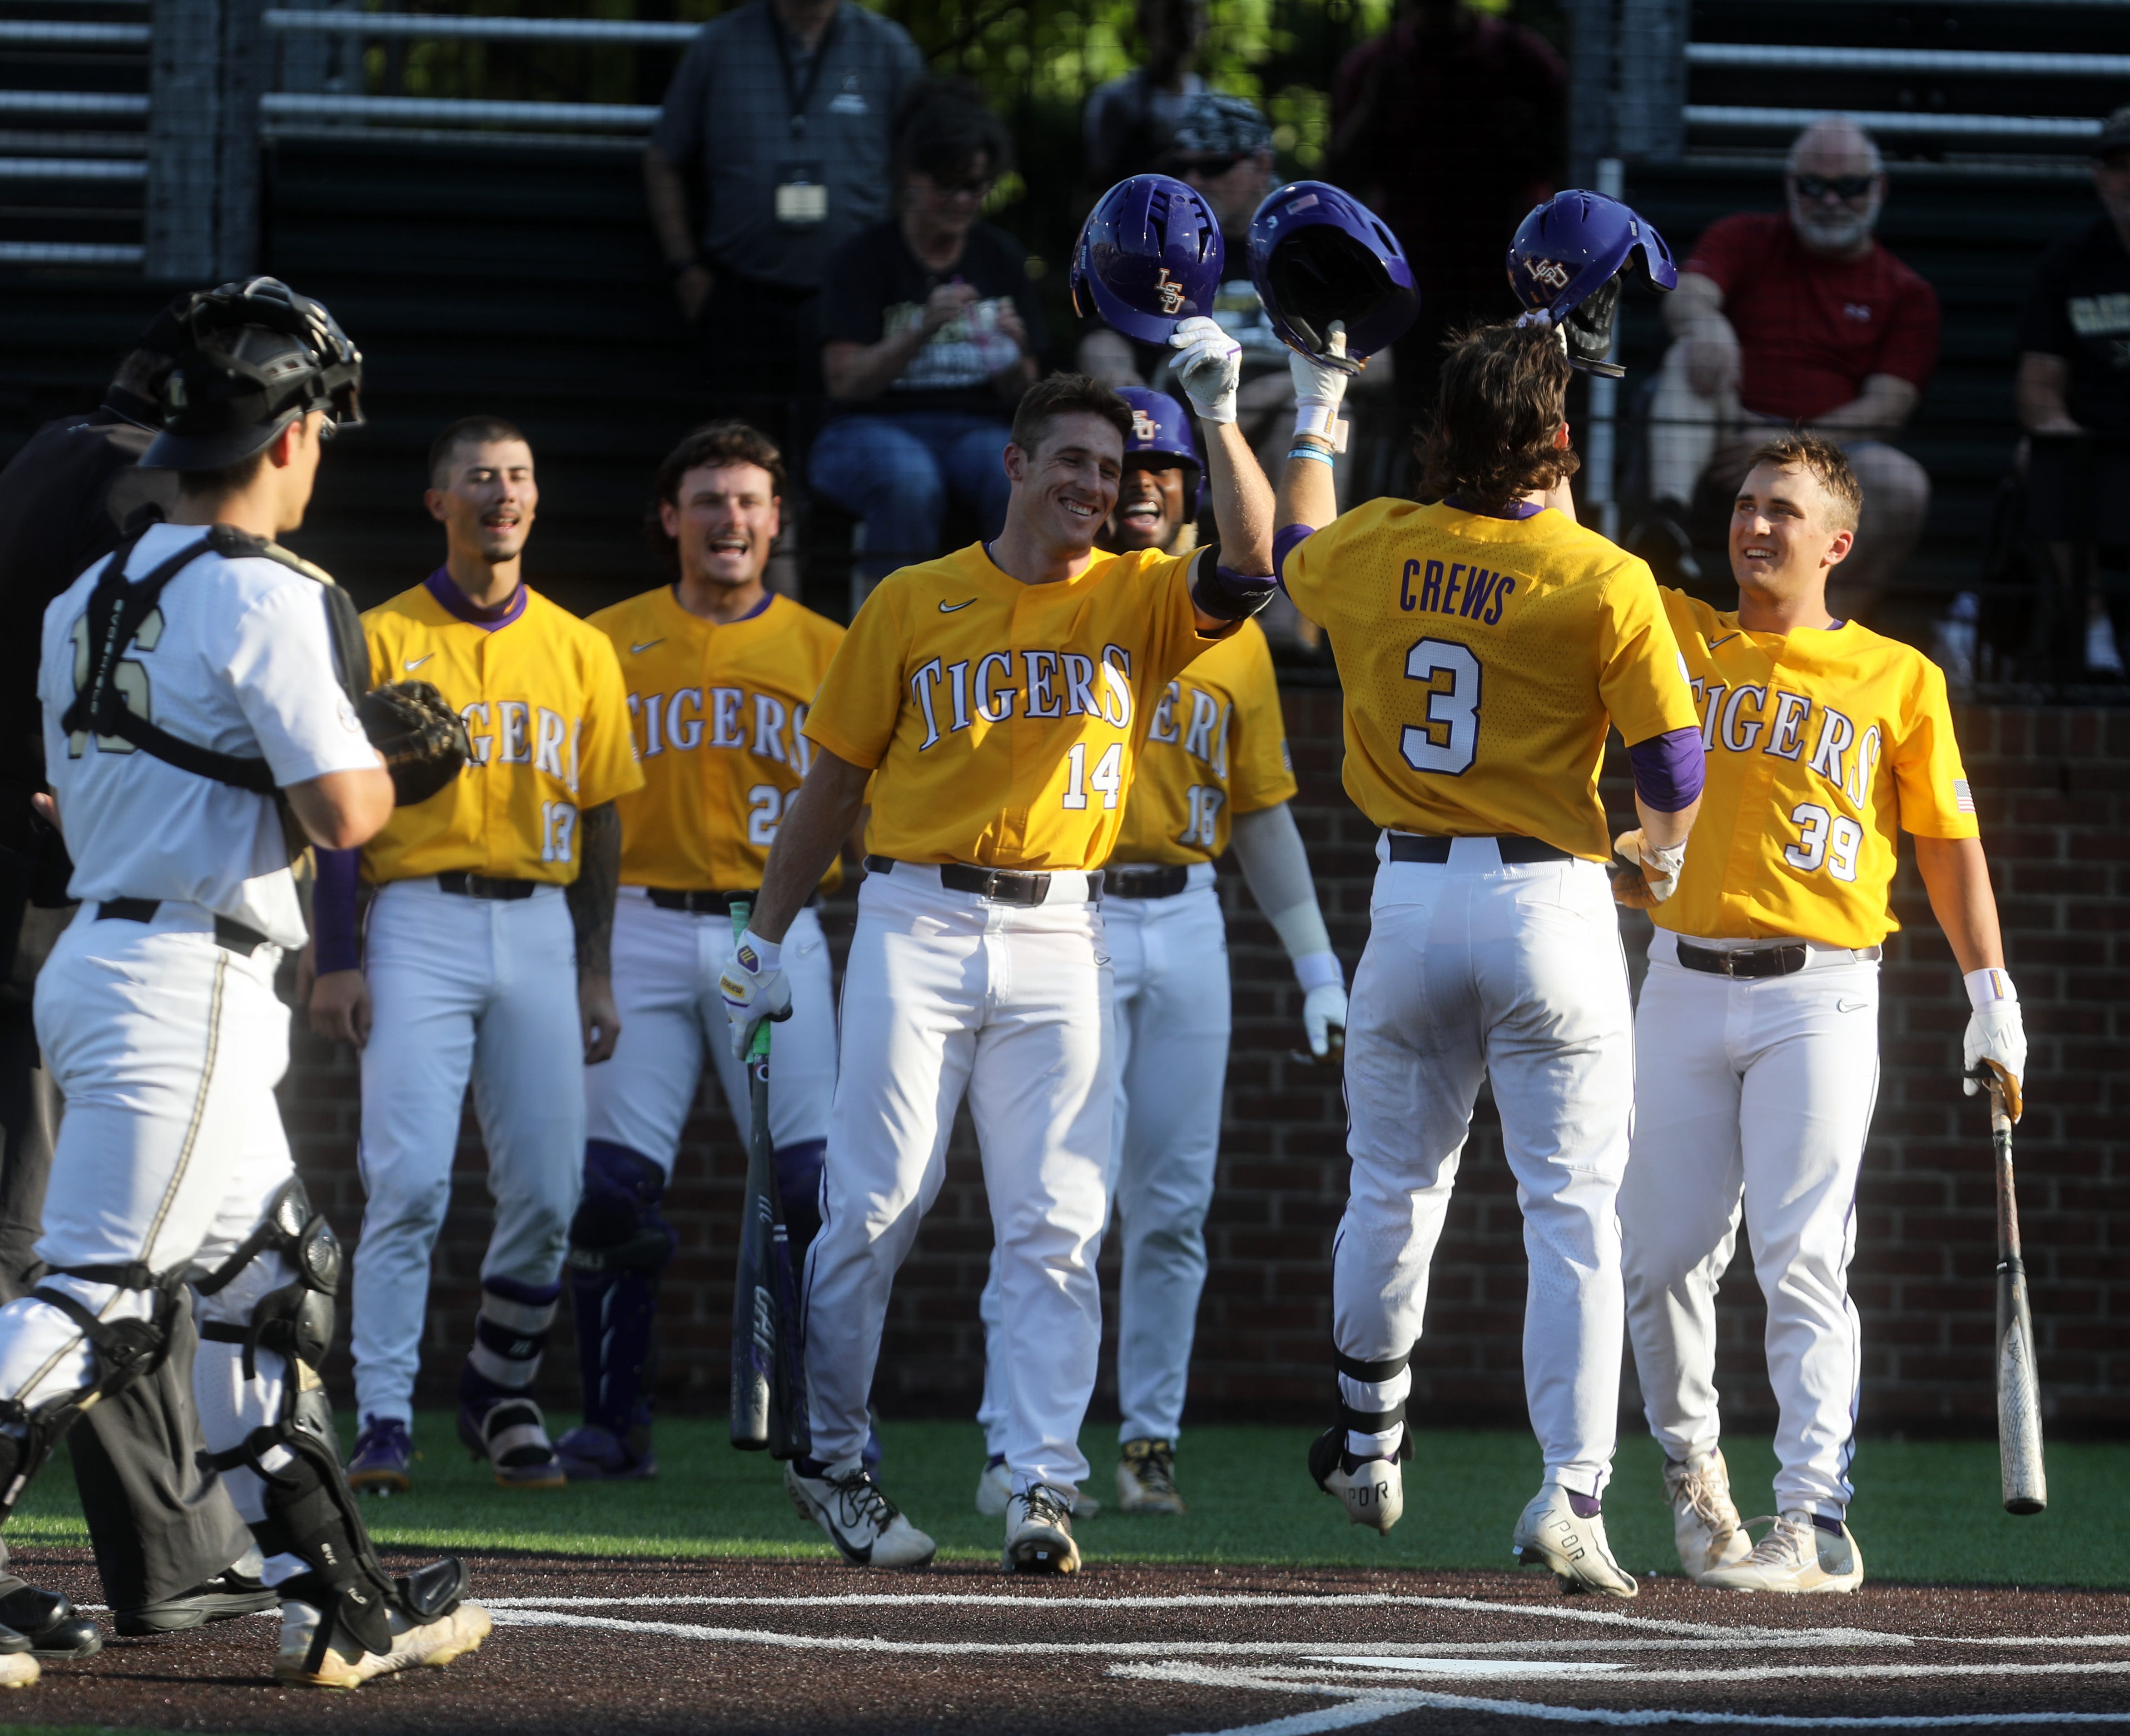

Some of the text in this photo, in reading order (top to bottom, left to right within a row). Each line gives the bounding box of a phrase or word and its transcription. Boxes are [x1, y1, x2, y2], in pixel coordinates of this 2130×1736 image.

[1154, 268, 1185, 314] LSU
[1523, 258, 1569, 289] LSU
[1132, 410, 1156, 440] SU
[1400, 559, 1516, 626] CREWS
[911, 643, 1132, 752] TIGERS
[1399, 636, 1483, 777] 3
[1062, 743, 1122, 810] 14
[541, 799, 578, 863] 13
[1178, 784, 1226, 847] 18
[1783, 803, 1863, 883] 39
[1346, 1479, 1389, 1507] POR
